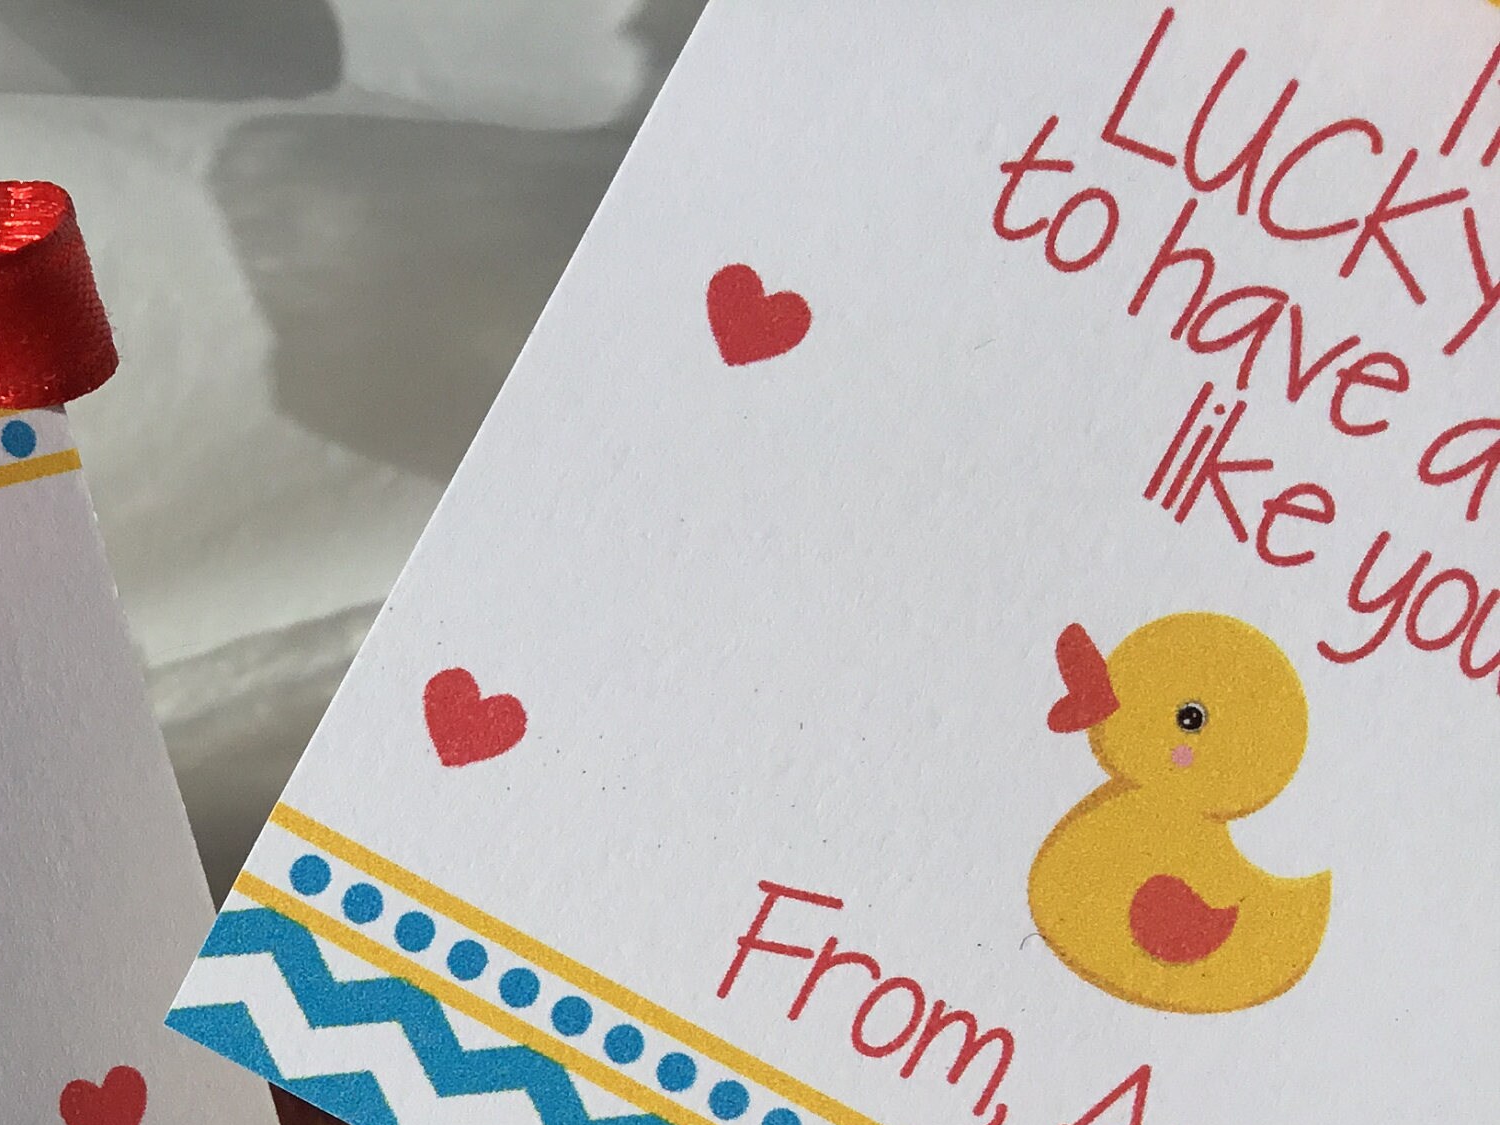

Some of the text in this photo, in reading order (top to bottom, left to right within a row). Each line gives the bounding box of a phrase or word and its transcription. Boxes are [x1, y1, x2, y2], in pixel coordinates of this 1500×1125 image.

[992, 114, 1500, 523] to have a
[1100, 6, 1500, 358] LUCKY
[1143, 381, 1336, 568] like
